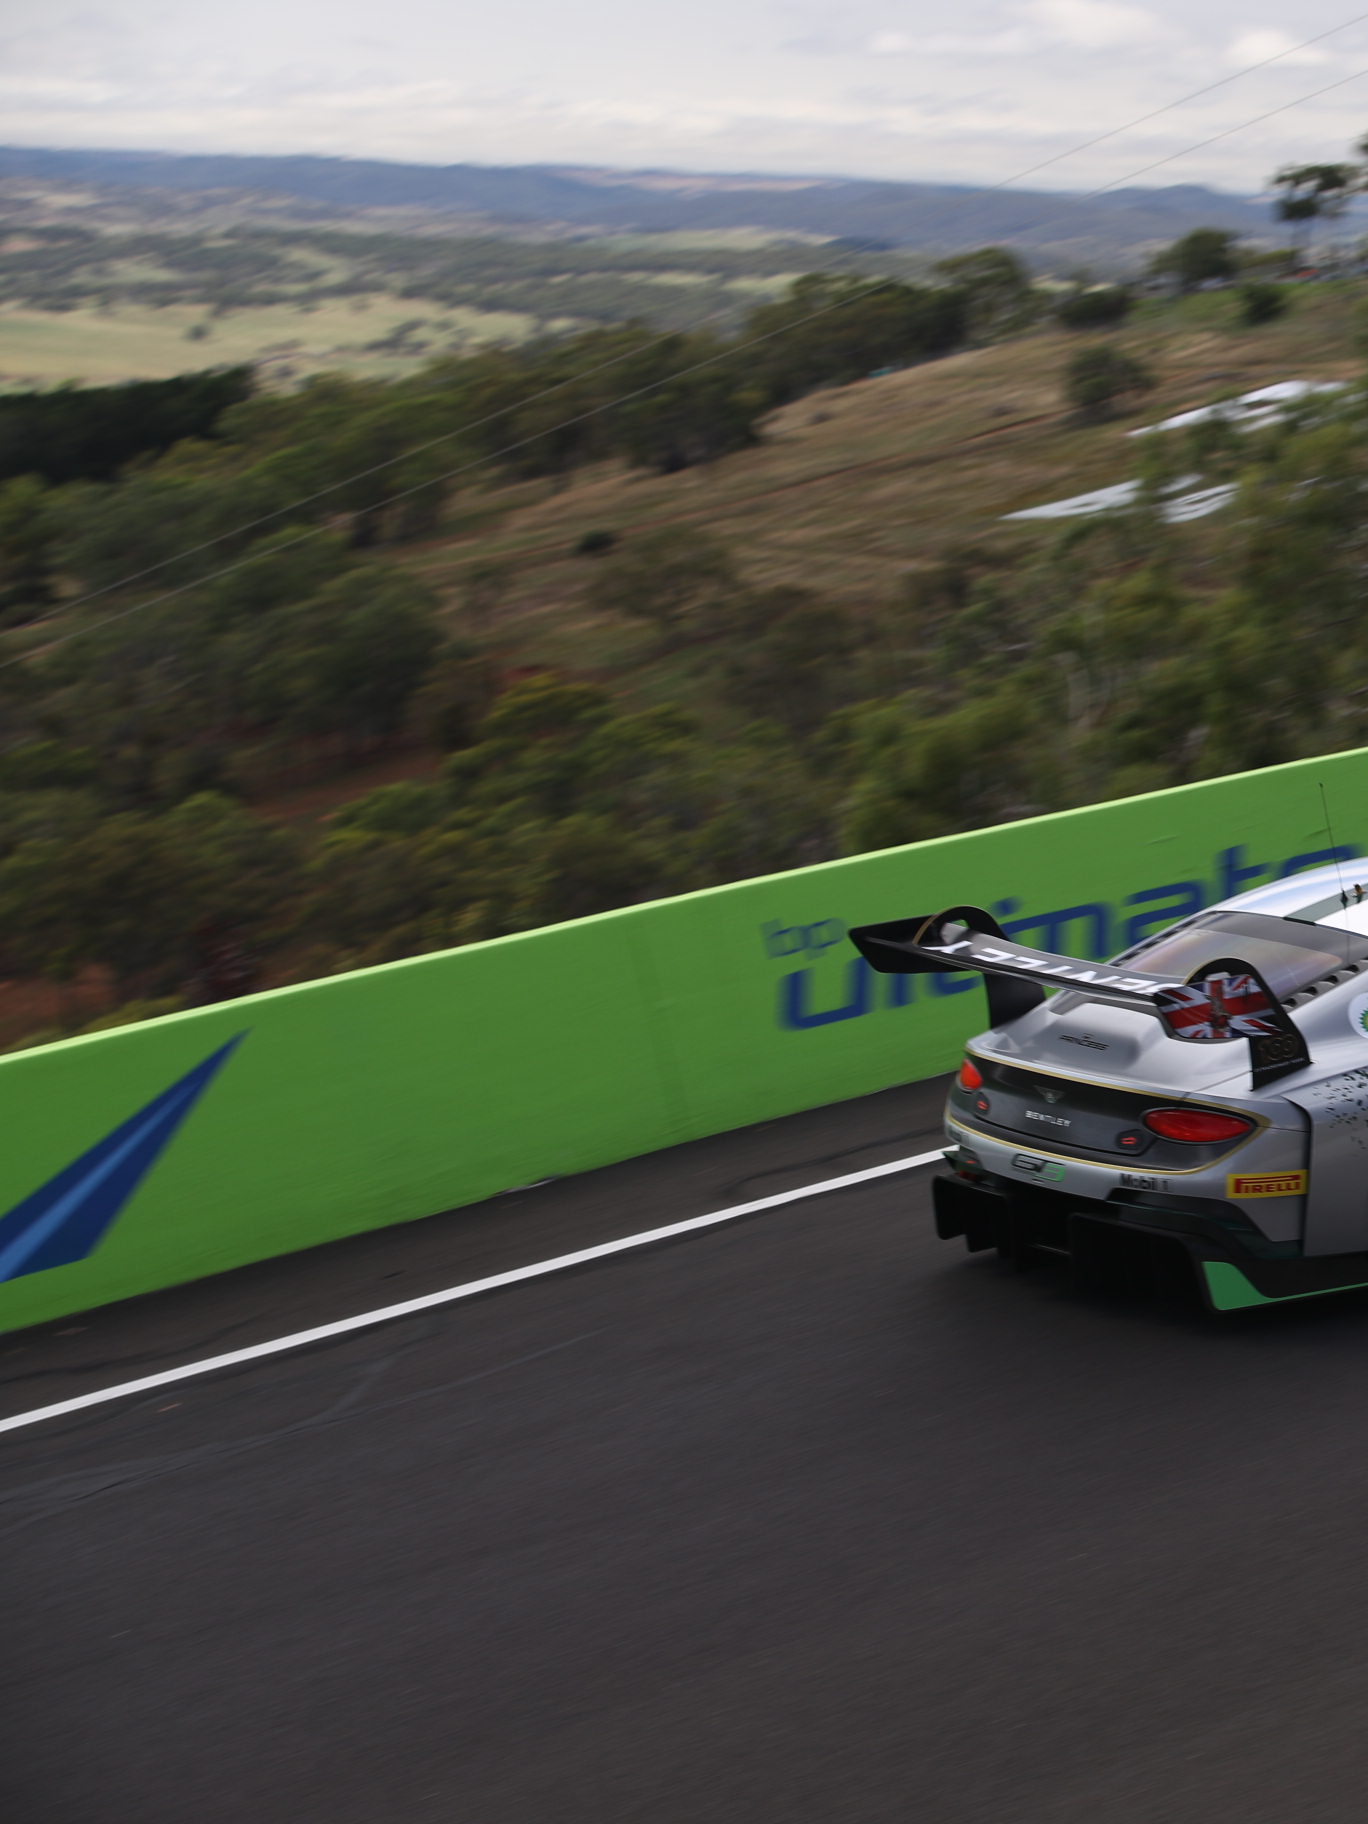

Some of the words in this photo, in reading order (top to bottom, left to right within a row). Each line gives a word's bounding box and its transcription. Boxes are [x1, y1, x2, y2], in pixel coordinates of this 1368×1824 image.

[761, 917, 847, 960] bp
[1025, 1110, 1071, 1127] BENTLEY
[1234, 1174, 1302, 1194] PIRELLI
